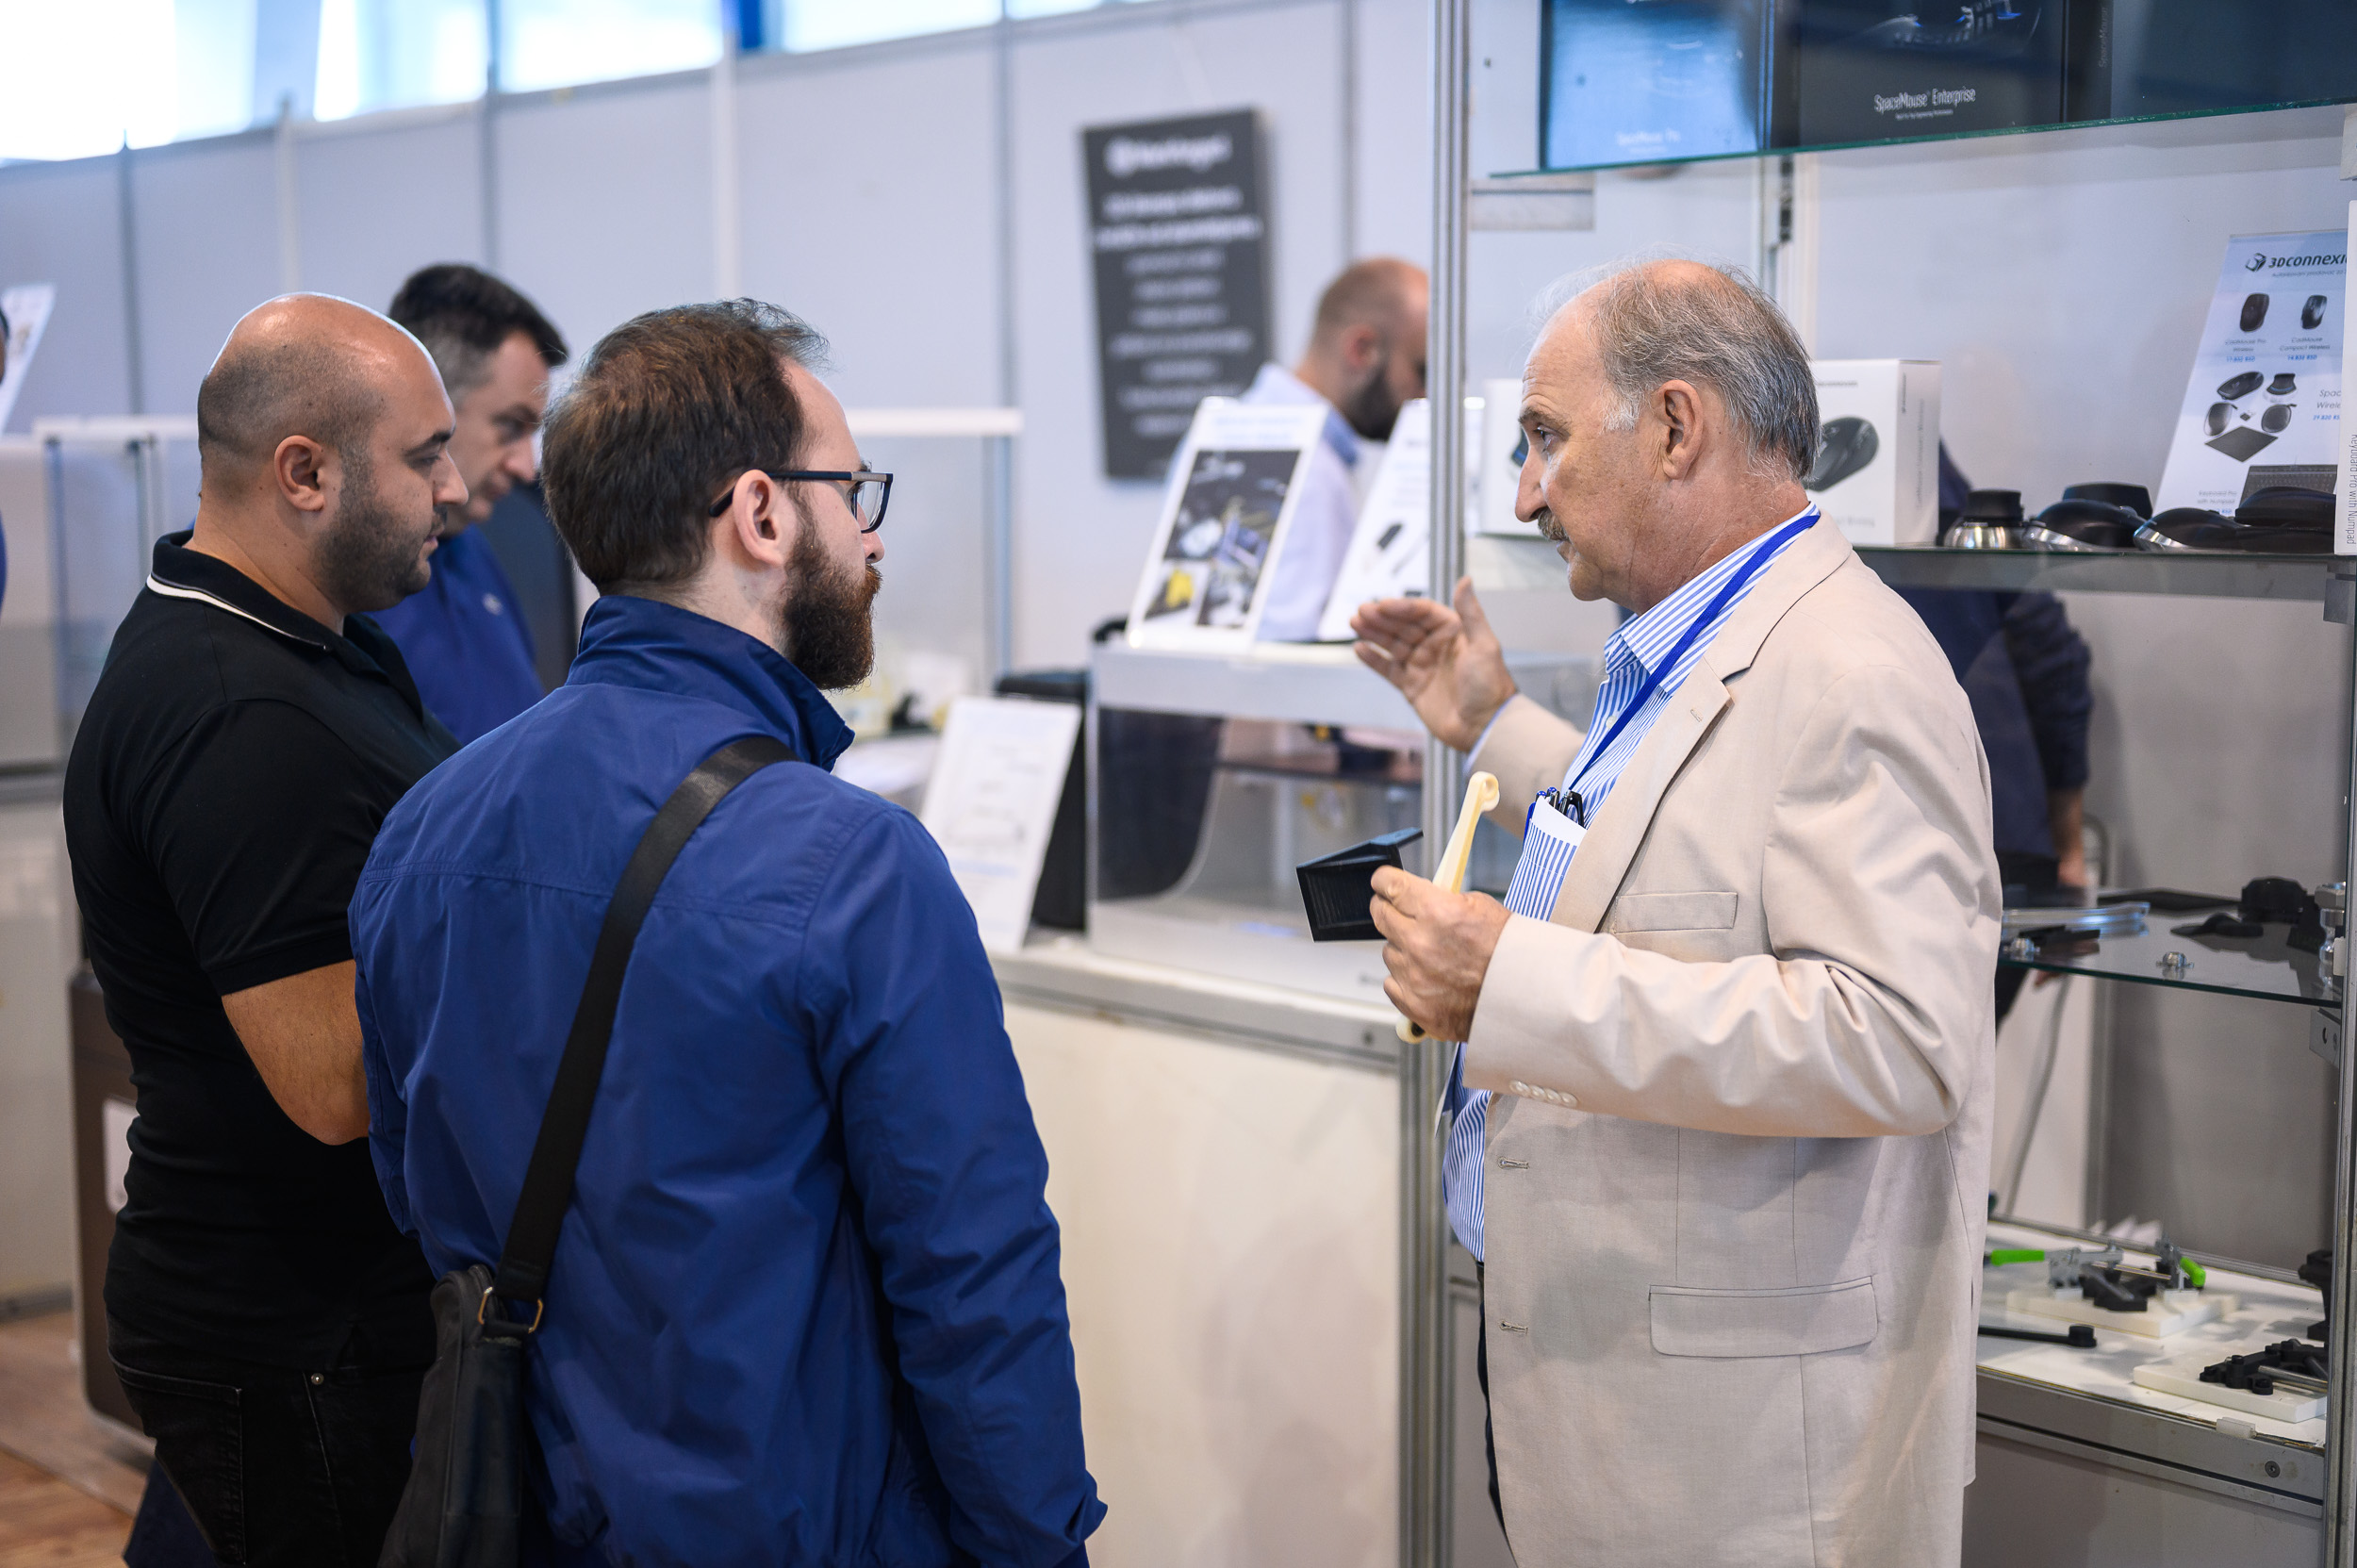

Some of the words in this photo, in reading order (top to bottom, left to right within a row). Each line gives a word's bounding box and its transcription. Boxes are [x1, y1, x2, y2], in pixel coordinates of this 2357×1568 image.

[1873, 92, 1928, 114] SpaceMouse
[1932, 86, 1976, 107] Enterprise
[2349, 474, 2357, 488] Pro
[2348, 491, 2357, 508] with
[2346, 510, 2357, 545] Numpad
